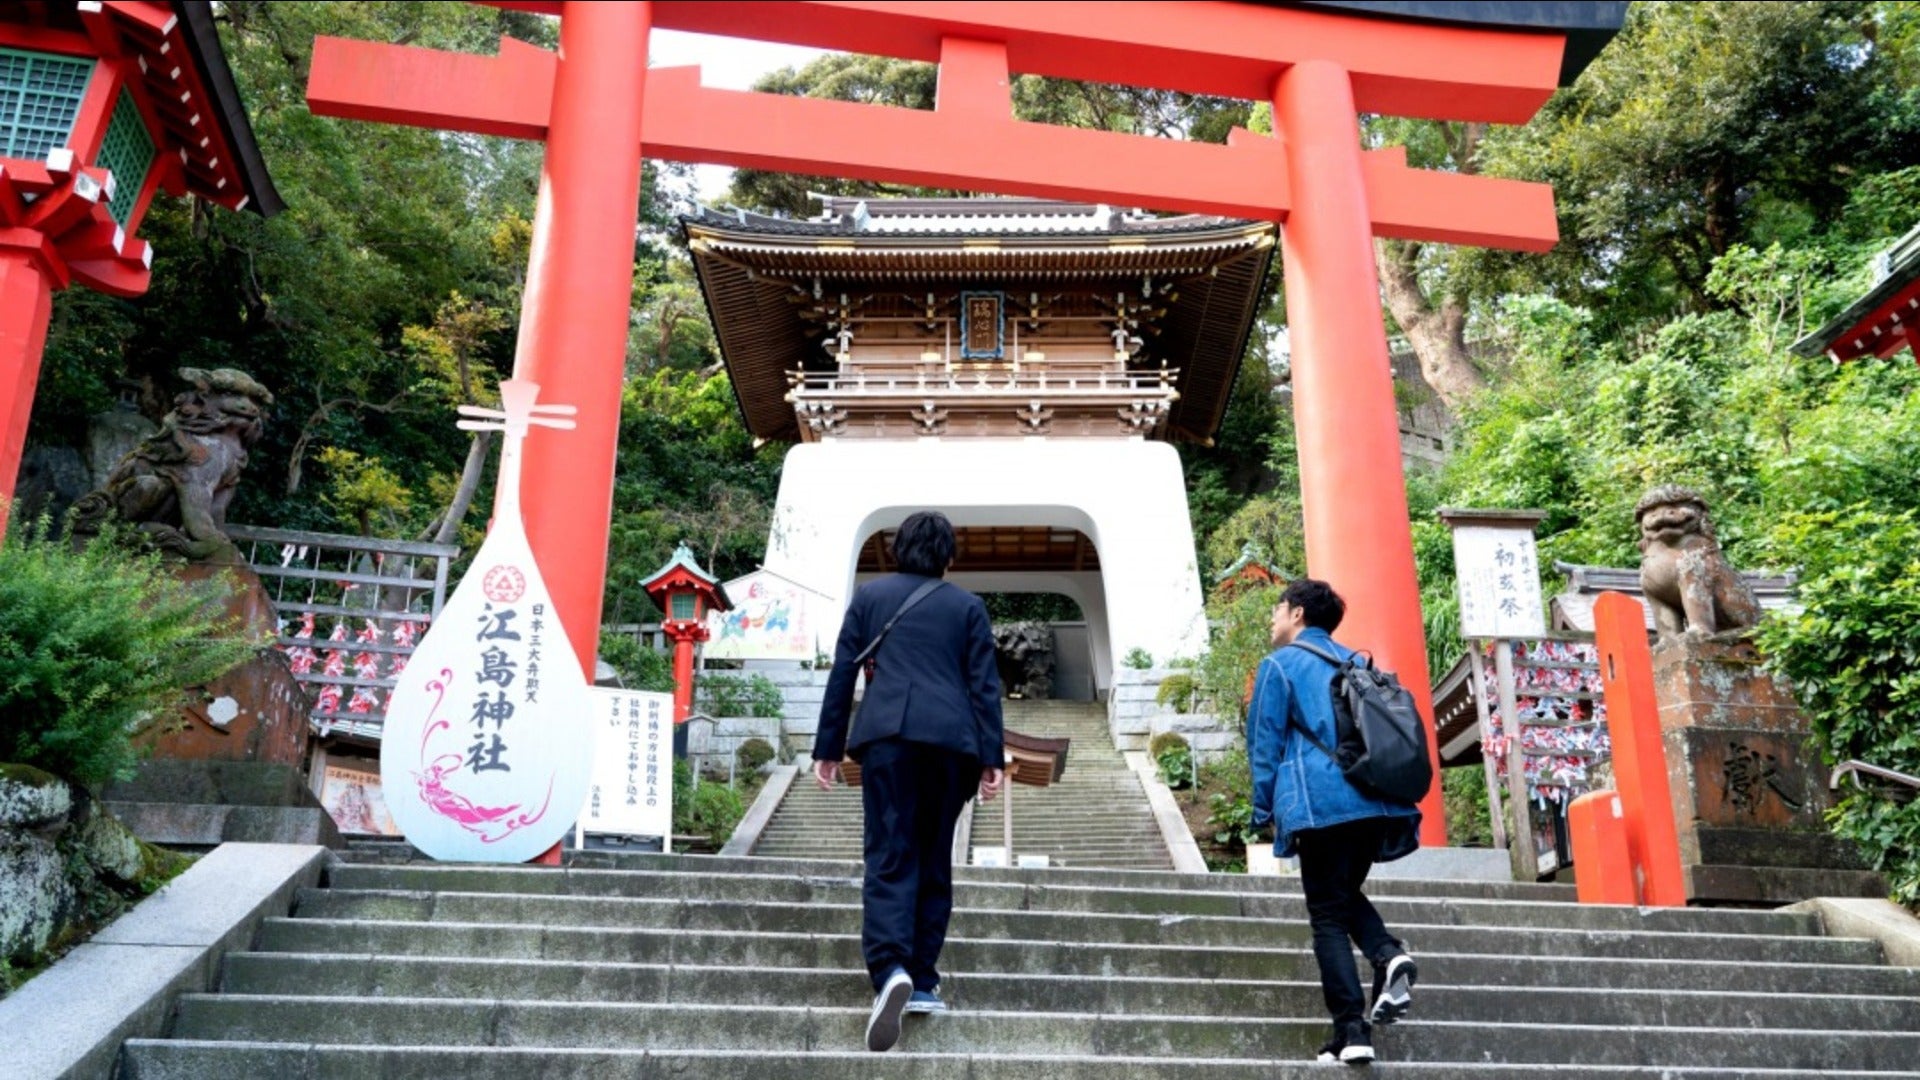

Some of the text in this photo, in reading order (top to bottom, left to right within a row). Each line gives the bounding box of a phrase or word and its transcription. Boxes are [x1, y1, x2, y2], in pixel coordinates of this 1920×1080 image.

[464, 602, 522, 775] 江島神社
[609, 696, 621, 727] 下さい
